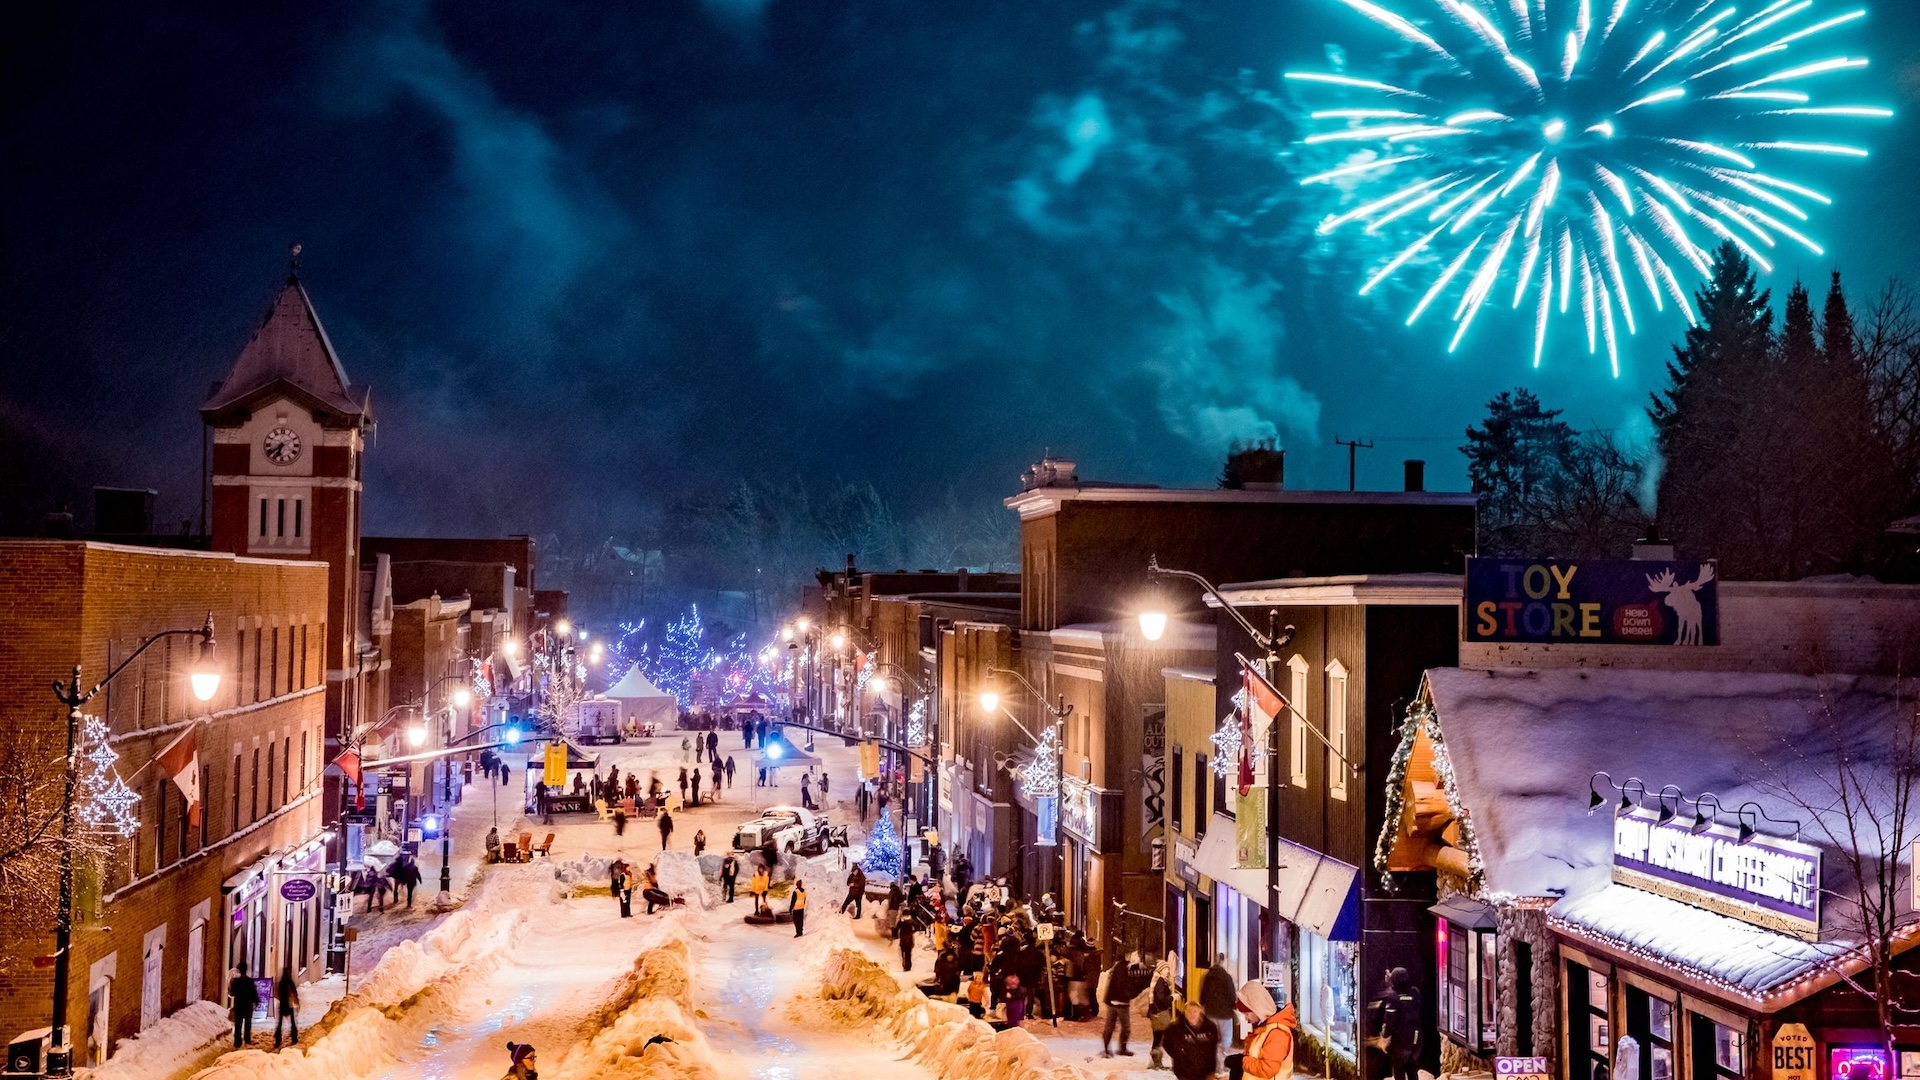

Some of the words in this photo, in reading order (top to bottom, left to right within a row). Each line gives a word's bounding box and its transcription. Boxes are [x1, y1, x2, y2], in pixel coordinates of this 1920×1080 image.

[1500, 564, 1577, 600] TOY
[1476, 600, 1601, 637] STORE
[1780, 1034, 1808, 1042] VOTED
[1497, 1059, 1547, 1074] OPEN
[1774, 1046, 1814, 1070] BEST
